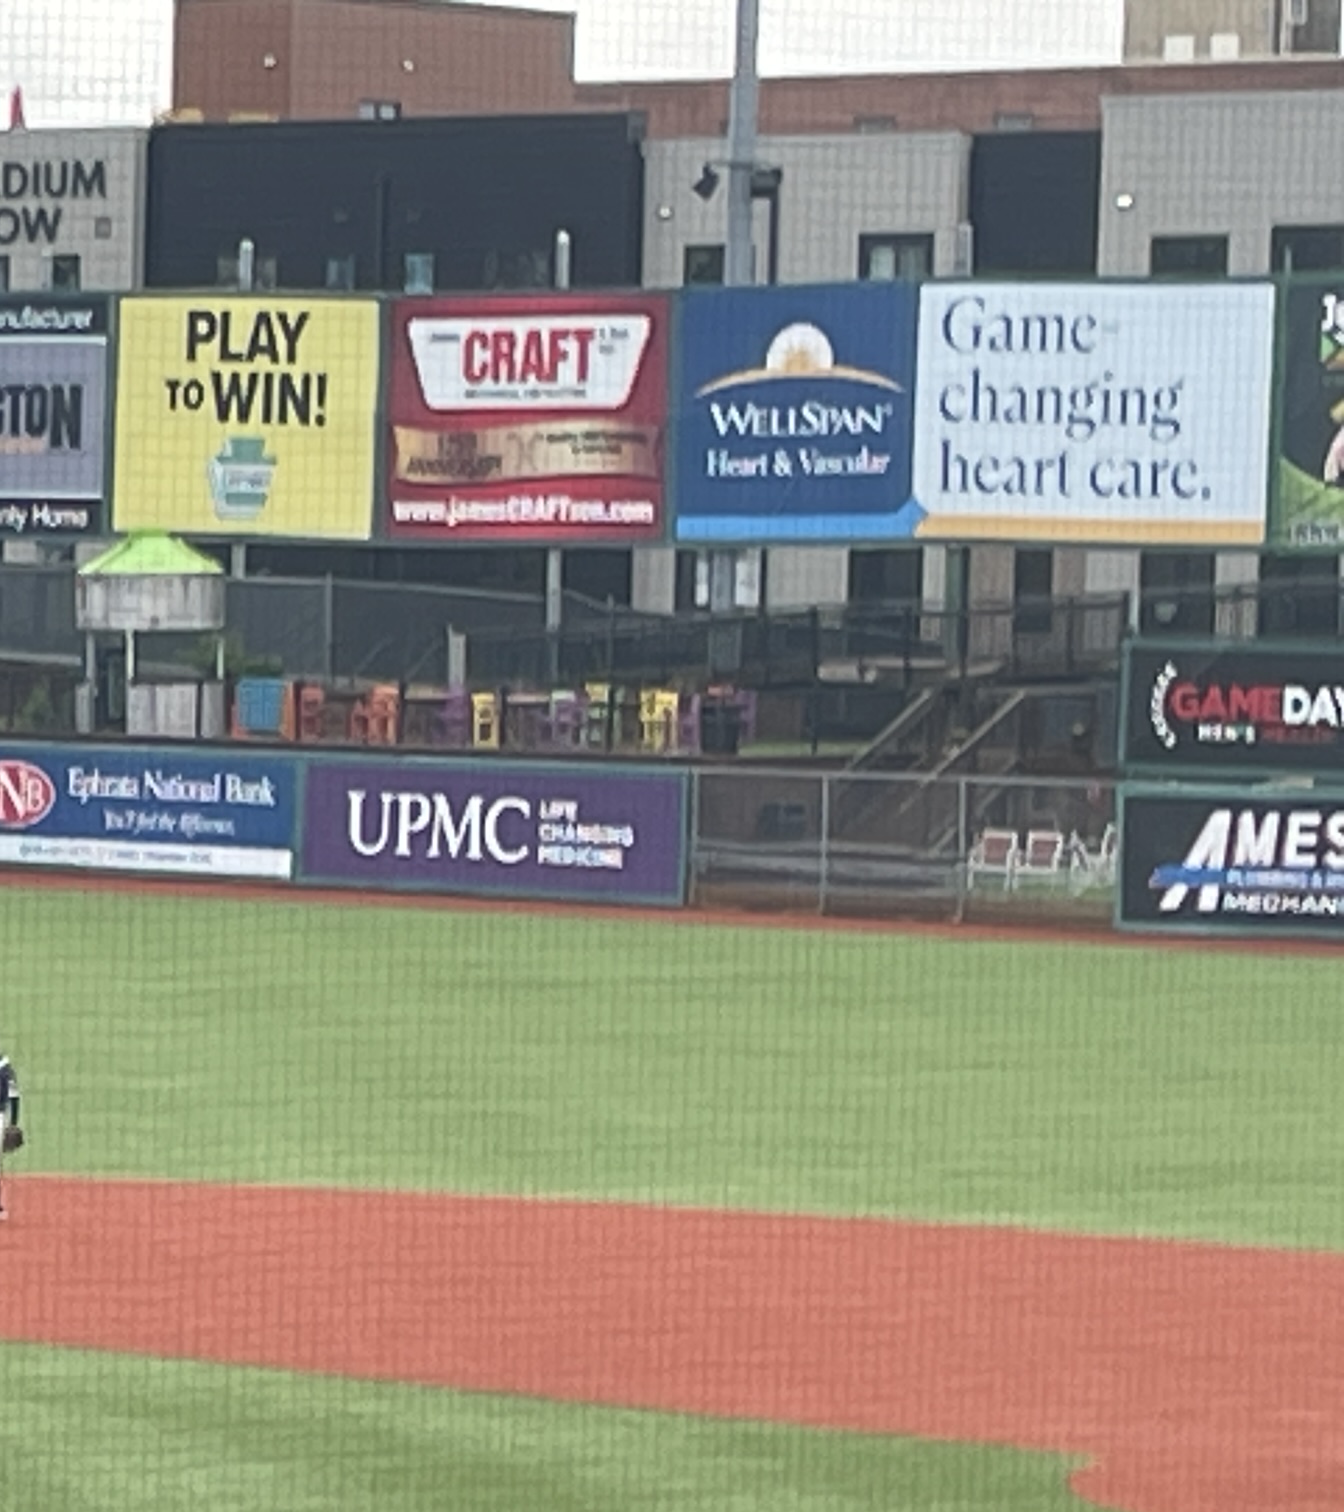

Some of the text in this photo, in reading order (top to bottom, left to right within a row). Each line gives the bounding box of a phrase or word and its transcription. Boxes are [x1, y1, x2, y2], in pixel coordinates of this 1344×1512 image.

[186, 310, 310, 364] PLAY
[941, 295, 1120, 355] Game-
[463, 328, 596, 384] CRAFT
[165, 371, 329, 426] TO WIN!
[938, 368, 1186, 443] changing
[707, 445, 892, 478] Heart & Vascular
[939, 440, 1212, 501] heart care.
[143, 770, 223, 804] National
[225, 773, 277, 808] Bank
[347, 788, 531, 866] UPMC
